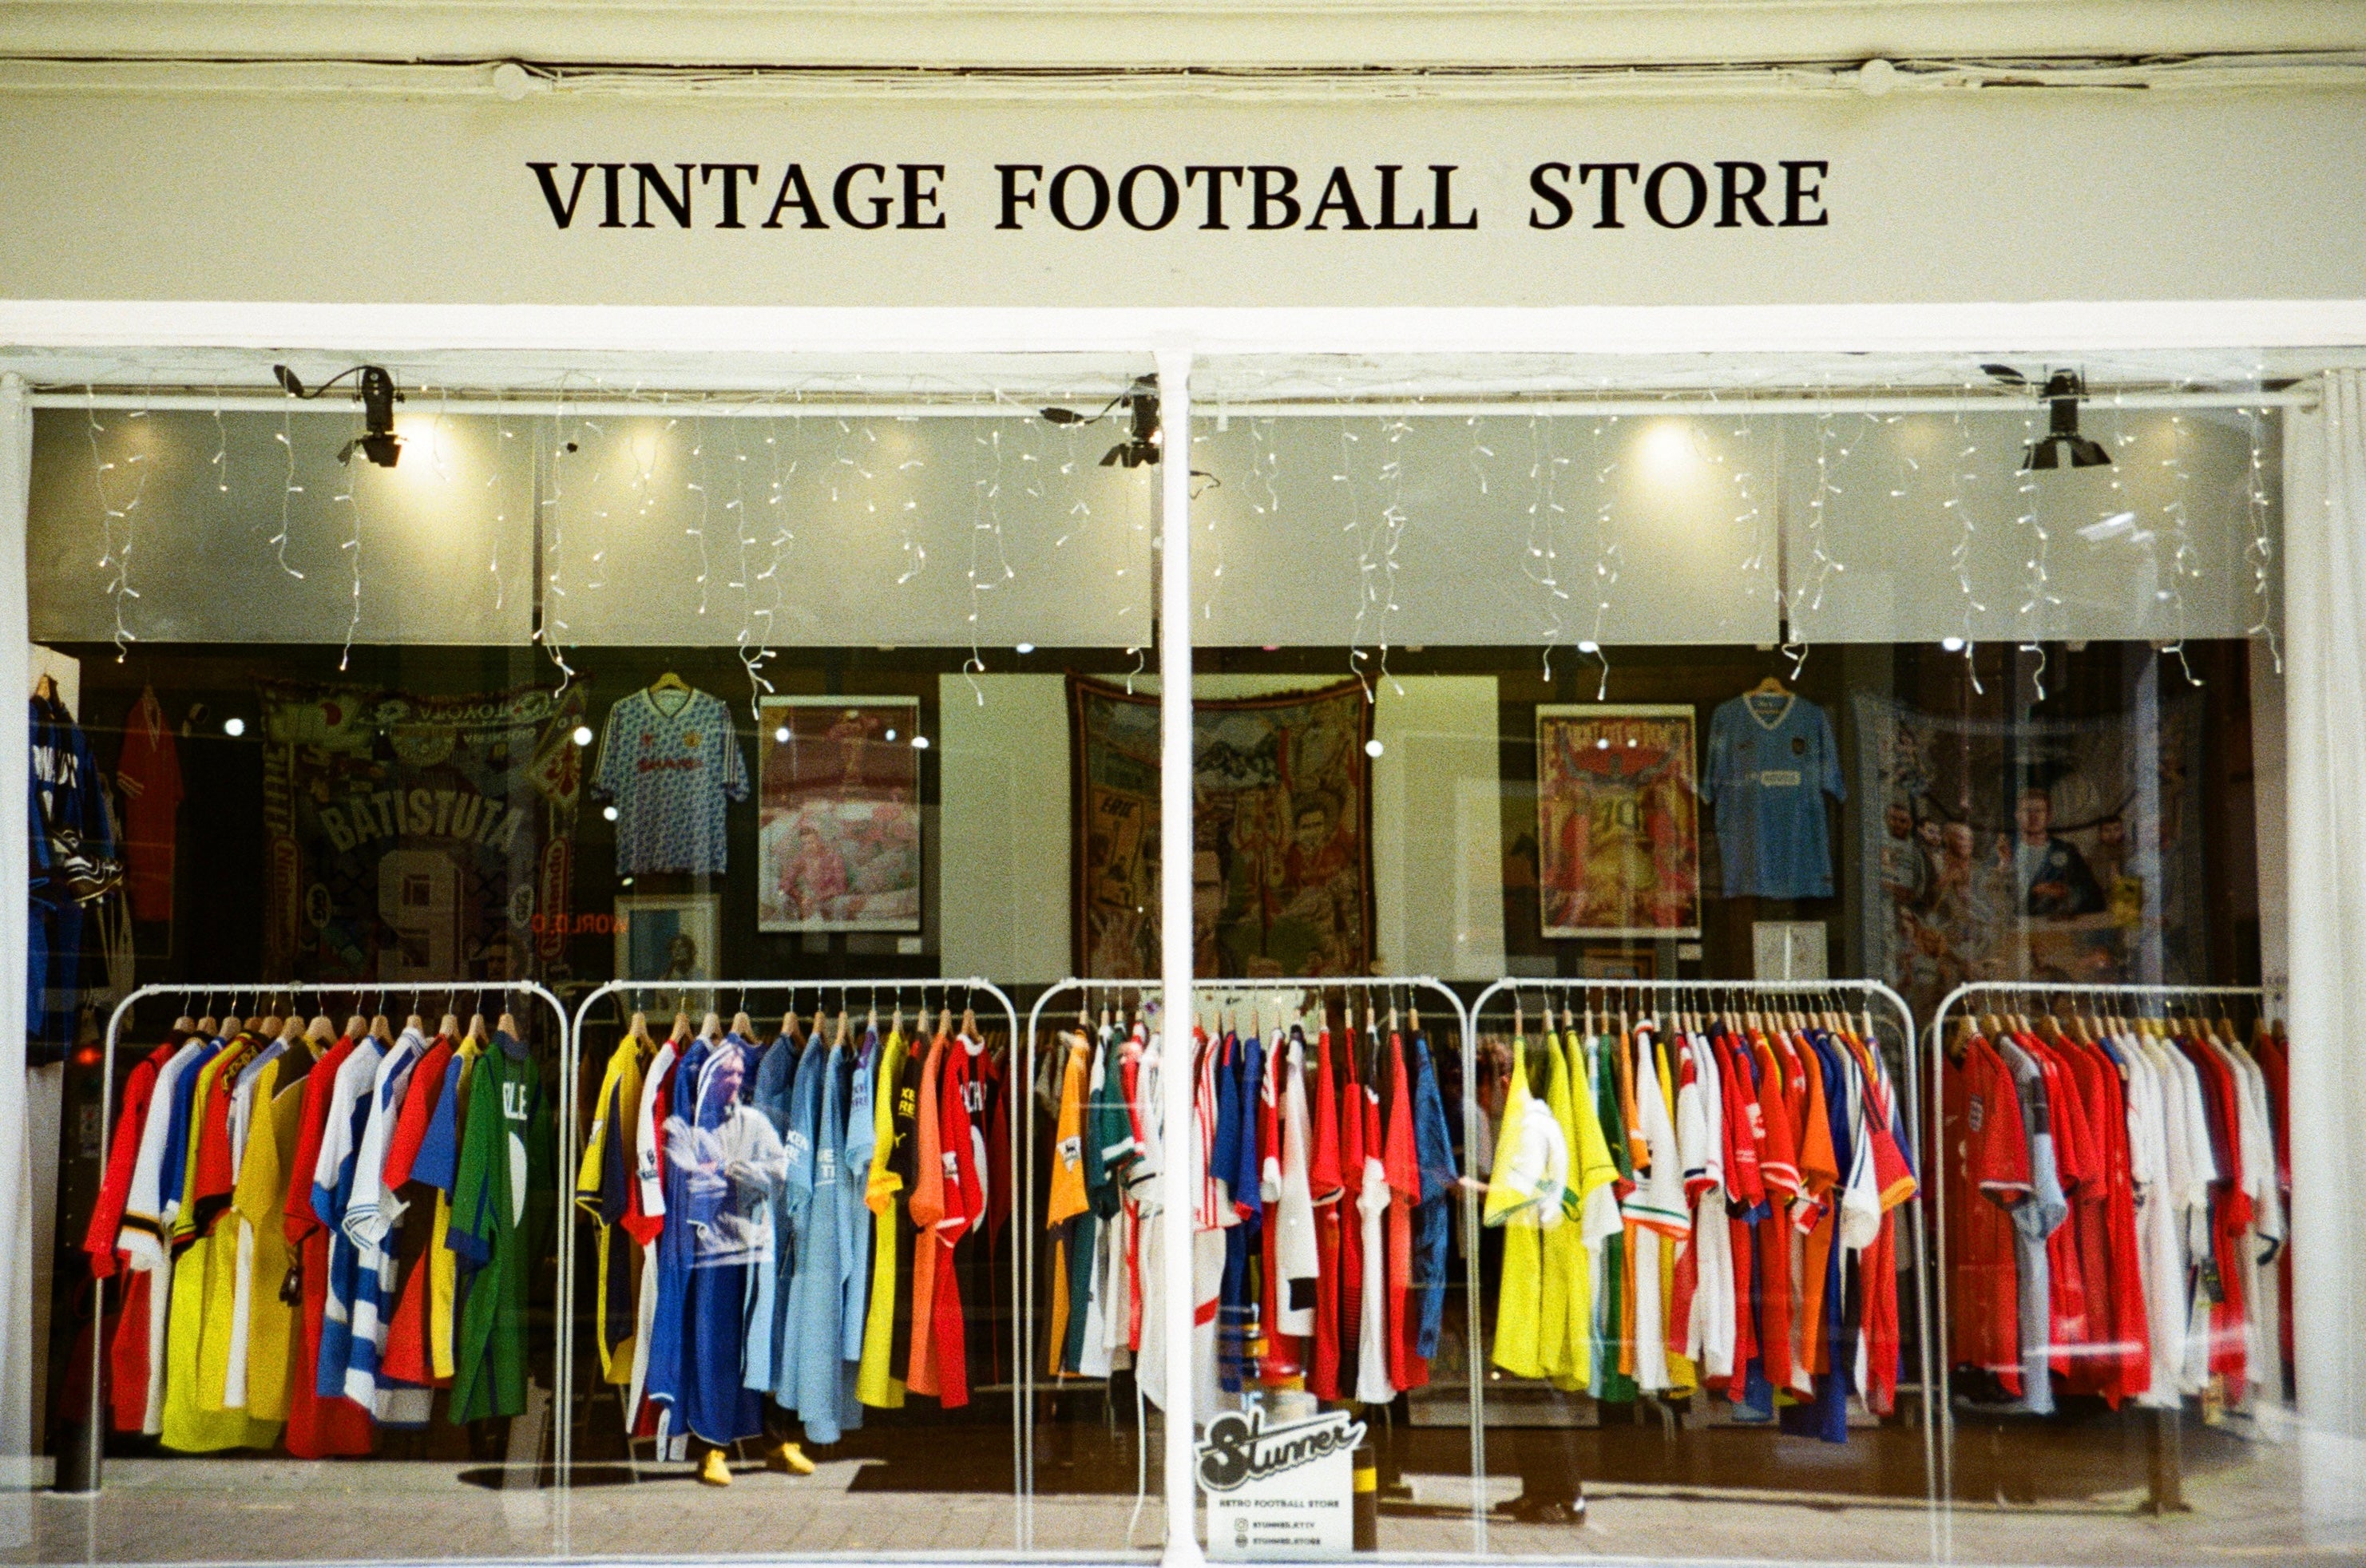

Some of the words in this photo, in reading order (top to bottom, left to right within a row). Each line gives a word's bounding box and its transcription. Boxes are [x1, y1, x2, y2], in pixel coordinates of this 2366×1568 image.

[525, 162, 945, 230] VINTAGE
[994, 164, 1478, 232] FOOTBALL
[1529, 160, 1829, 230] STORE
[320, 787, 524, 853] BATISTUTA
[378, 849, 458, 984] 9
[543, 846, 563, 951] Nintendo
[1198, 1411, 1359, 1486] Stunner
[1219, 1499, 1252, 1508] RETRO
[1254, 1499, 1305, 1508] FOOTBALL
[1308, 1499, 1340, 1508] STORE
